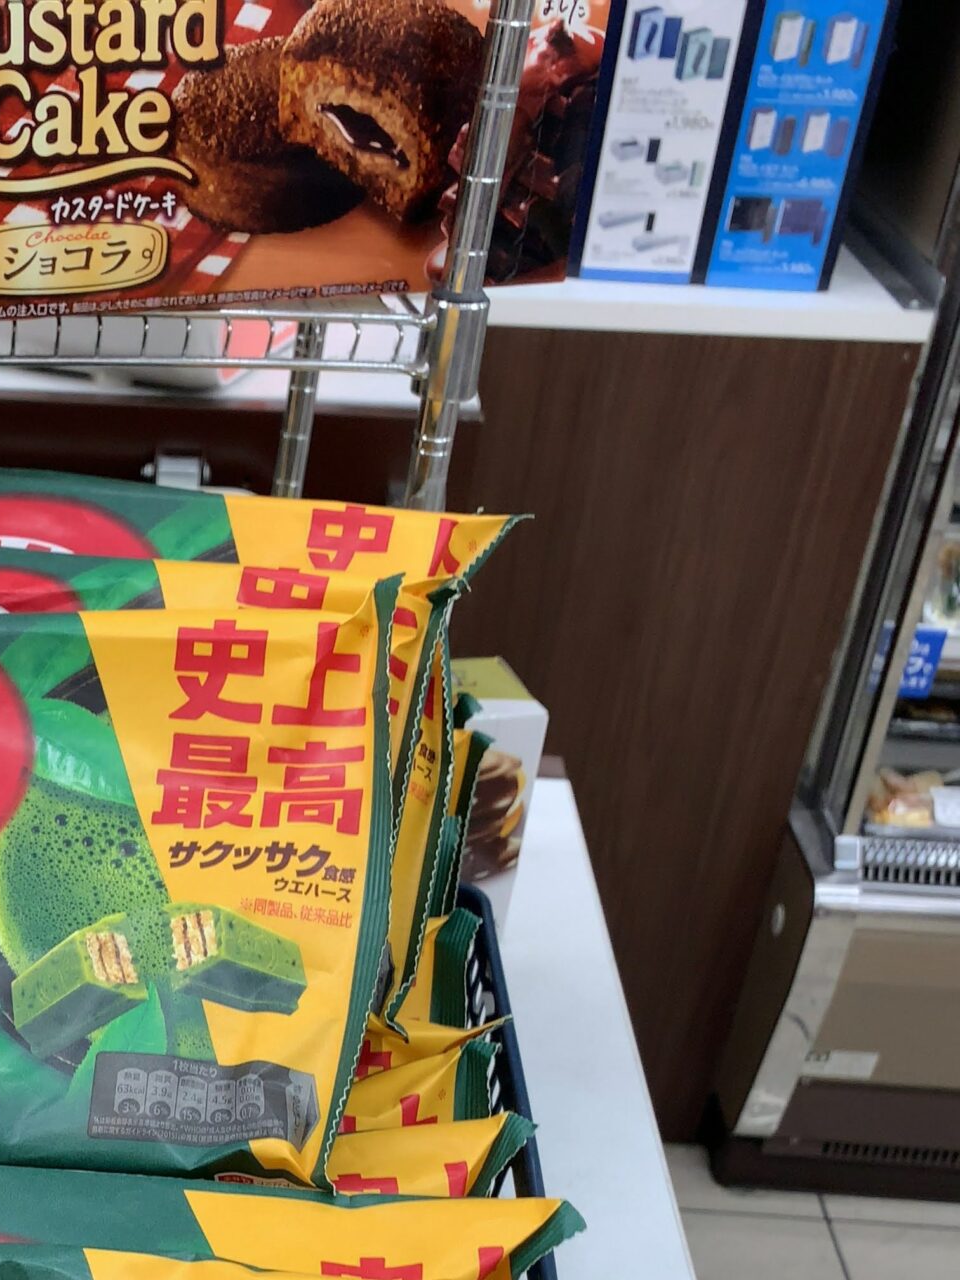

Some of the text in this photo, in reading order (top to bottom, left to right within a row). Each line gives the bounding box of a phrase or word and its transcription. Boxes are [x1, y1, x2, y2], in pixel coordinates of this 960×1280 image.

[51, 191, 176, 224] カスタードケーキ
[25, 229, 111, 248] Chocolat
[3, 240, 132, 281] ショコラ
[168, 619, 367, 728] 史上
[151, 732, 366, 836] 最高
[274, 877, 352, 903] ウエハース
